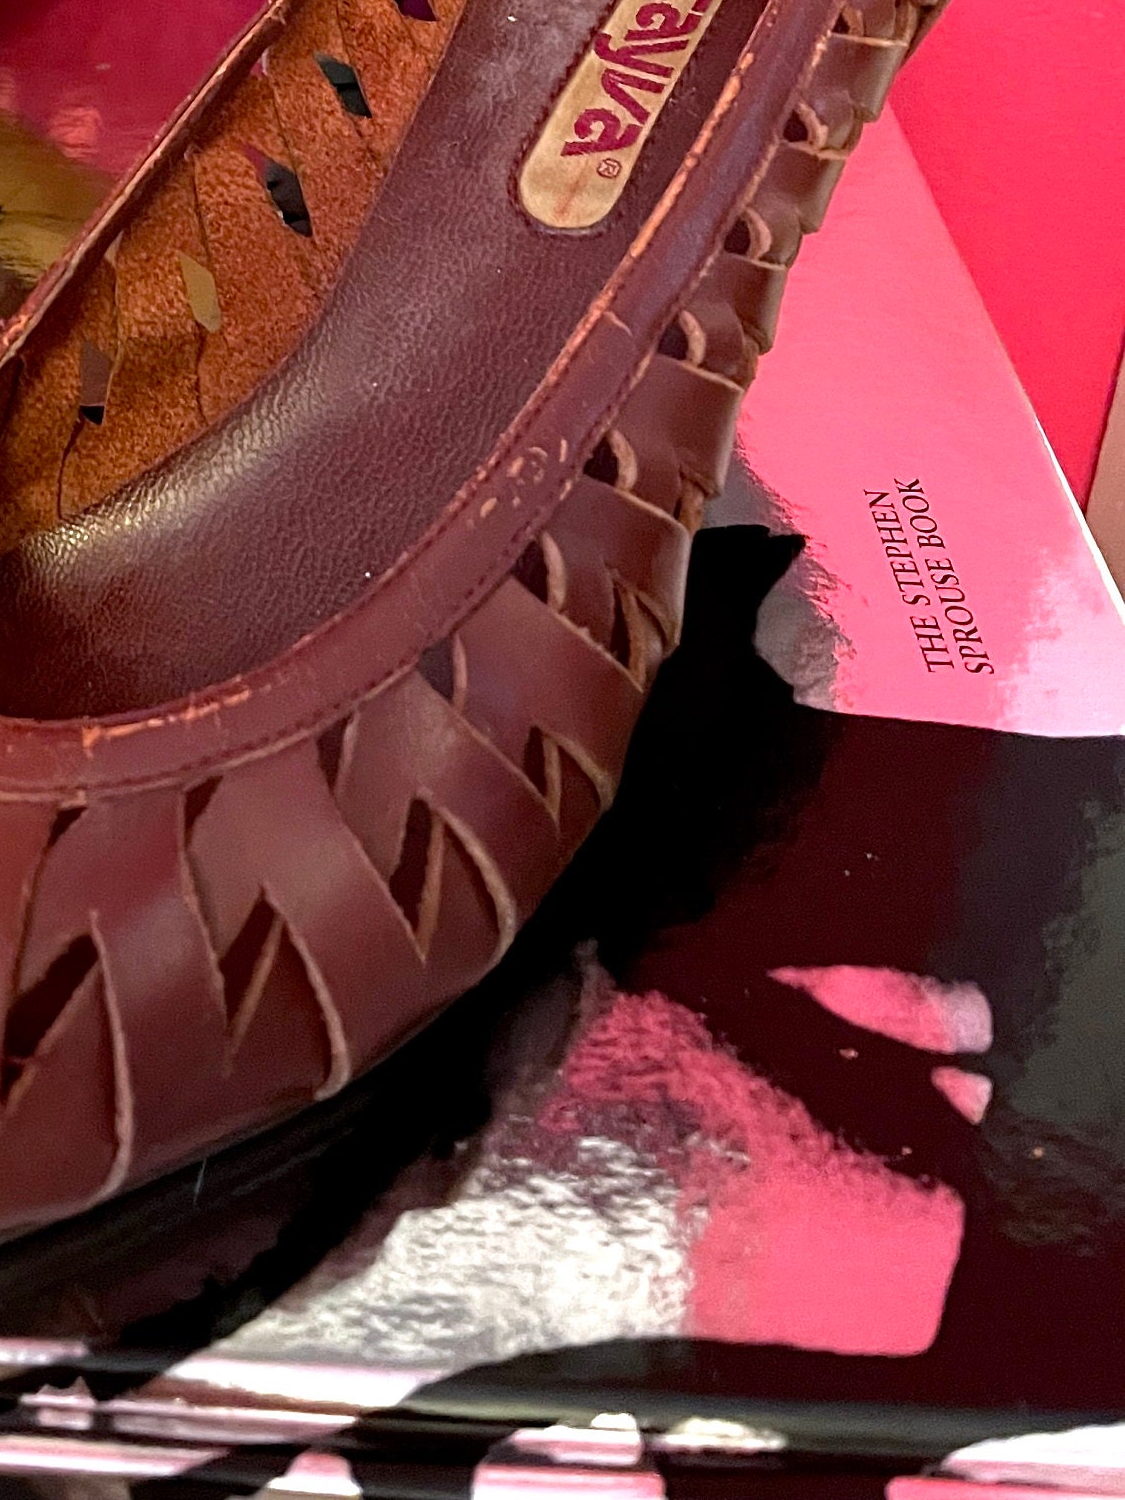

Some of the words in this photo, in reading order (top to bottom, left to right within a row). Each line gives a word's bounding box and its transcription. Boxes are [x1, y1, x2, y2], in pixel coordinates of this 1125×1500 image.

[863, 489, 931, 606] STEPHEN
[893, 478, 946, 549] BOOK
[910, 616, 955, 673] THE
[924, 558, 995, 675] SPROUSE
